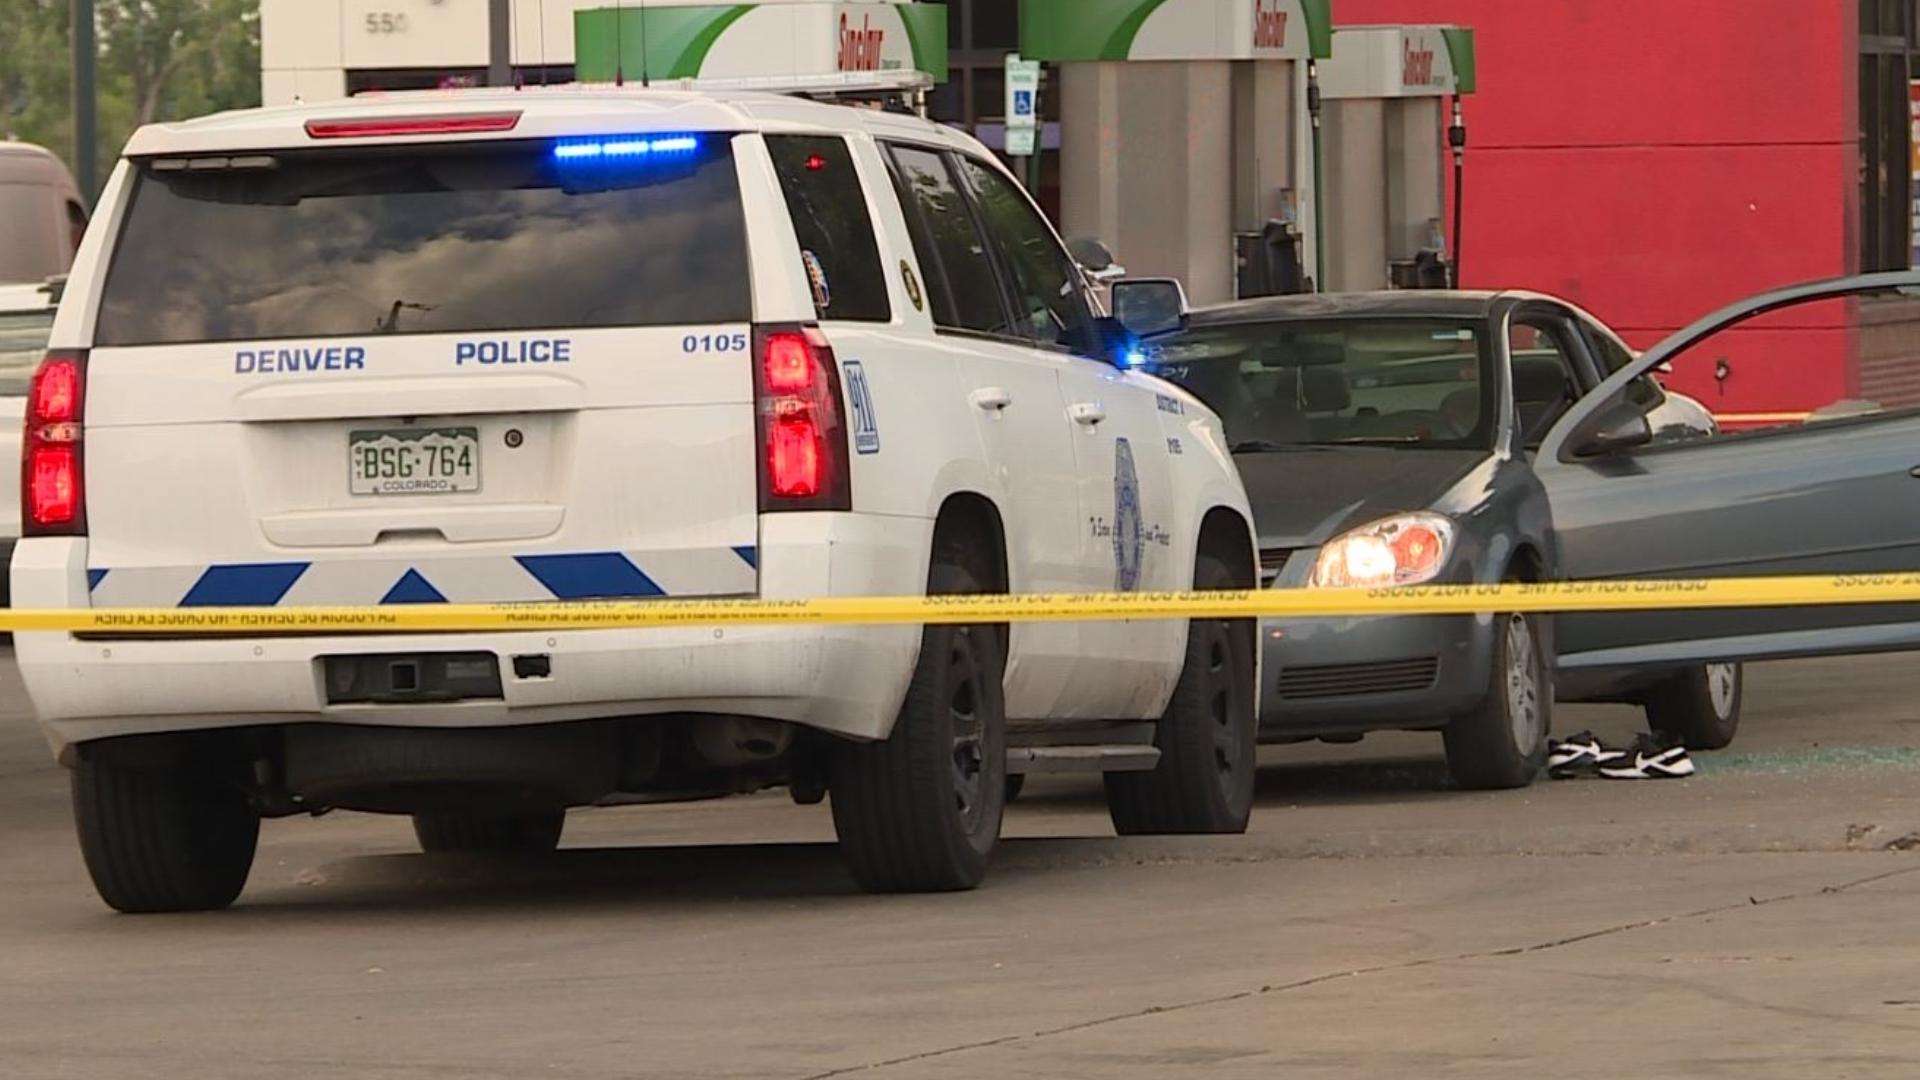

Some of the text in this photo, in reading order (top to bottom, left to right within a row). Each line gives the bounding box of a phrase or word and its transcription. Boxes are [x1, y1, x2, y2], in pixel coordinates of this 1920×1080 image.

[838, 12, 883, 71] Sinclair
[234, 339, 571, 373] DENVER POLICE
[682, 333, 747, 353] 0105
[847, 368, 875, 433] 911
[382, 479, 448, 491] COLORADO
